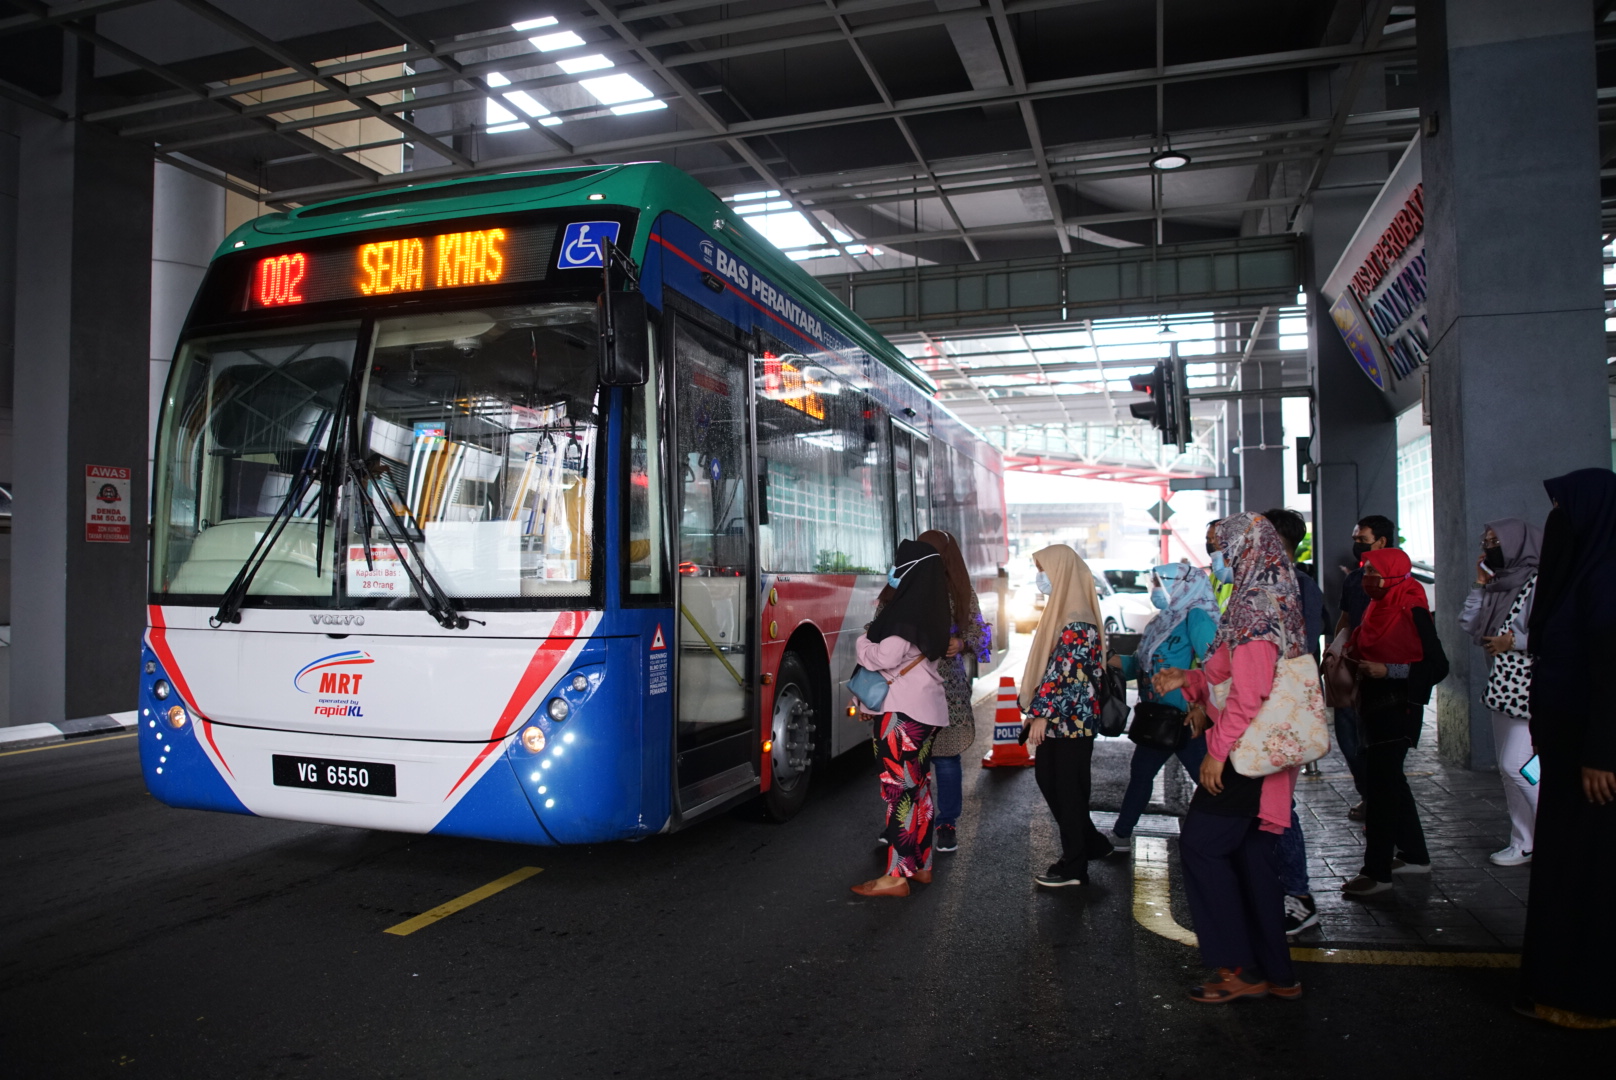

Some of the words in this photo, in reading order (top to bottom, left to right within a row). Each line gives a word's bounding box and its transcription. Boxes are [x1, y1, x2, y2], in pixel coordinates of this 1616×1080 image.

[1349, 250, 1385, 302] PUSAT
[1372, 182, 1425, 271] PERUBAT
[260, 252, 305, 306] 002
[360, 237, 424, 294] SEWA
[436, 227, 505, 287] KHAS
[716, 248, 748, 289] BAS
[751, 273, 823, 342] PERANTARA
[91, 467, 126, 478] AWAS
[356, 569, 383, 577] Kapasiti
[373, 581, 394, 590] Orang
[309, 614, 365, 626] VOLVO
[318, 672, 363, 695] MRT
[314, 704, 364, 718] rapidKL
[997, 728, 1021, 738] POLIS
[297, 762, 318, 782] VG
[326, 766, 369, 788] 6550
